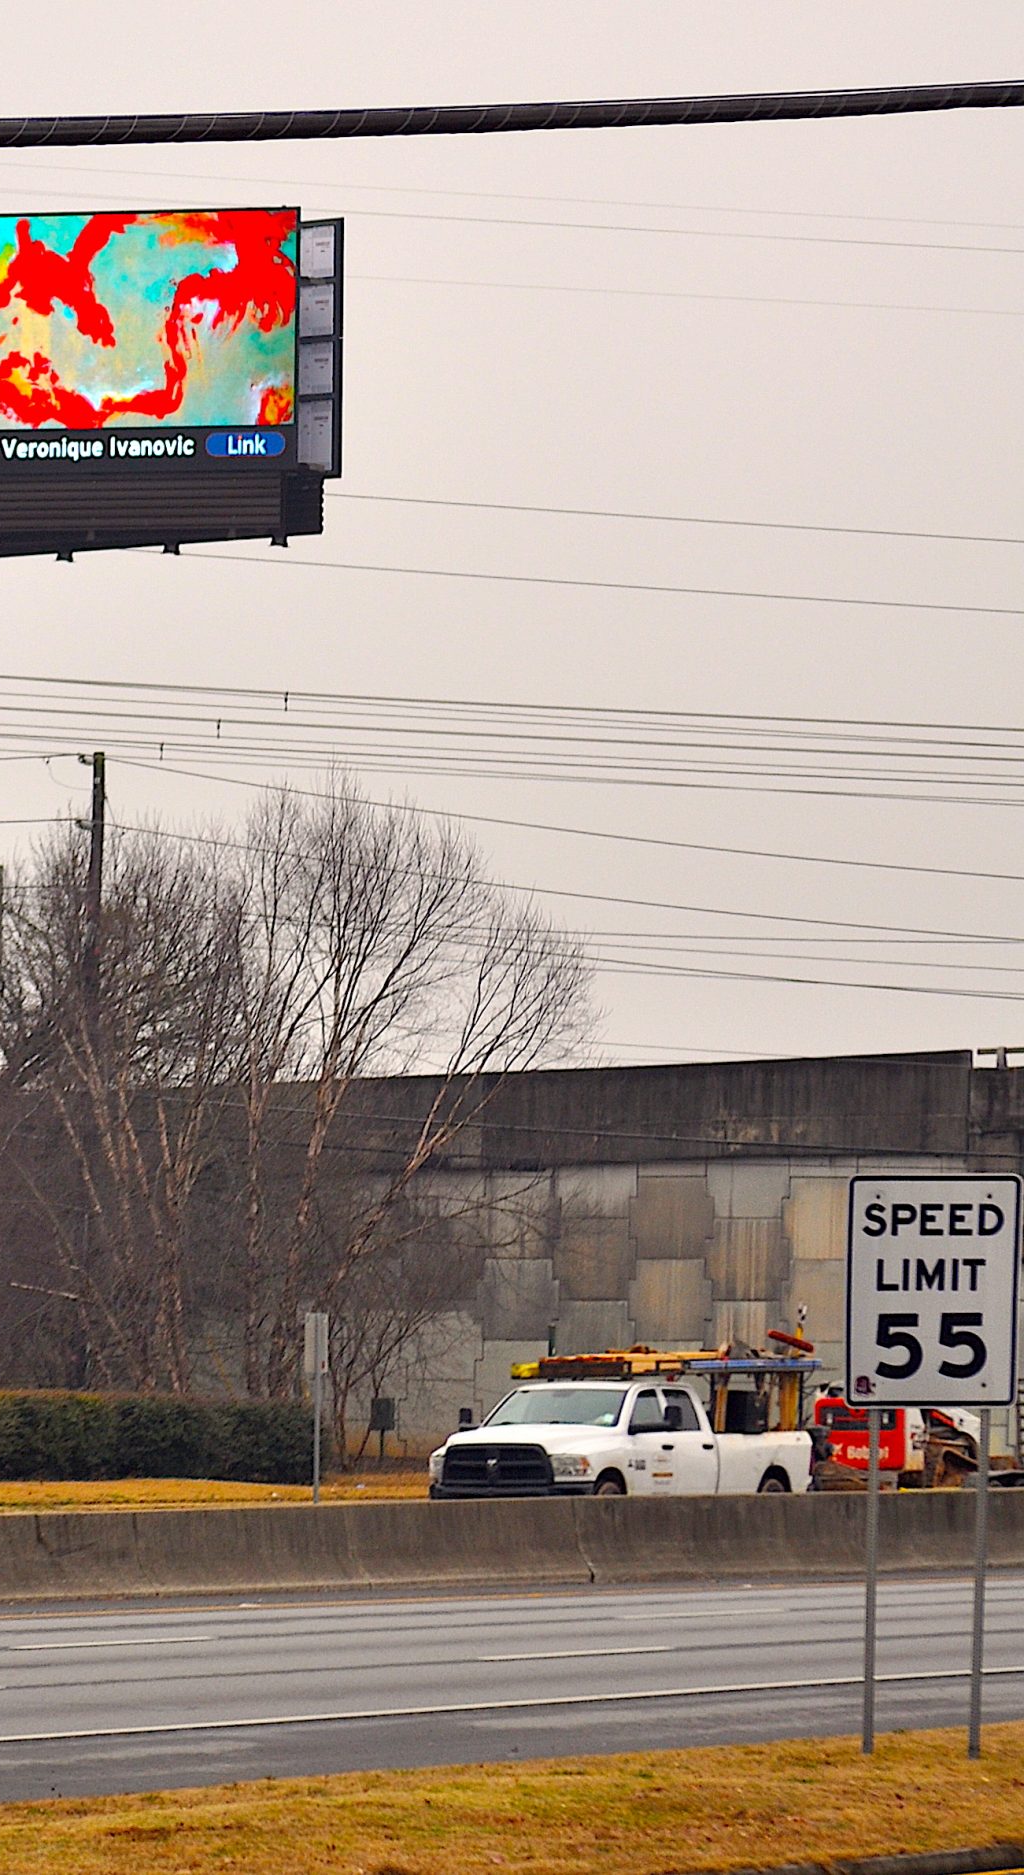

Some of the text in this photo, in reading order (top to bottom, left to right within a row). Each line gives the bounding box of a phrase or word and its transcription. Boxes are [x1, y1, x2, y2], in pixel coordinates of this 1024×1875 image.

[1, 434, 195, 461] Veronique Ivanovic
[227, 434, 266, 456] Link
[862, 1203, 1005, 1237] SPEED
[876, 1258, 987, 1292] LIMIT
[875, 1312, 988, 1380] 55
